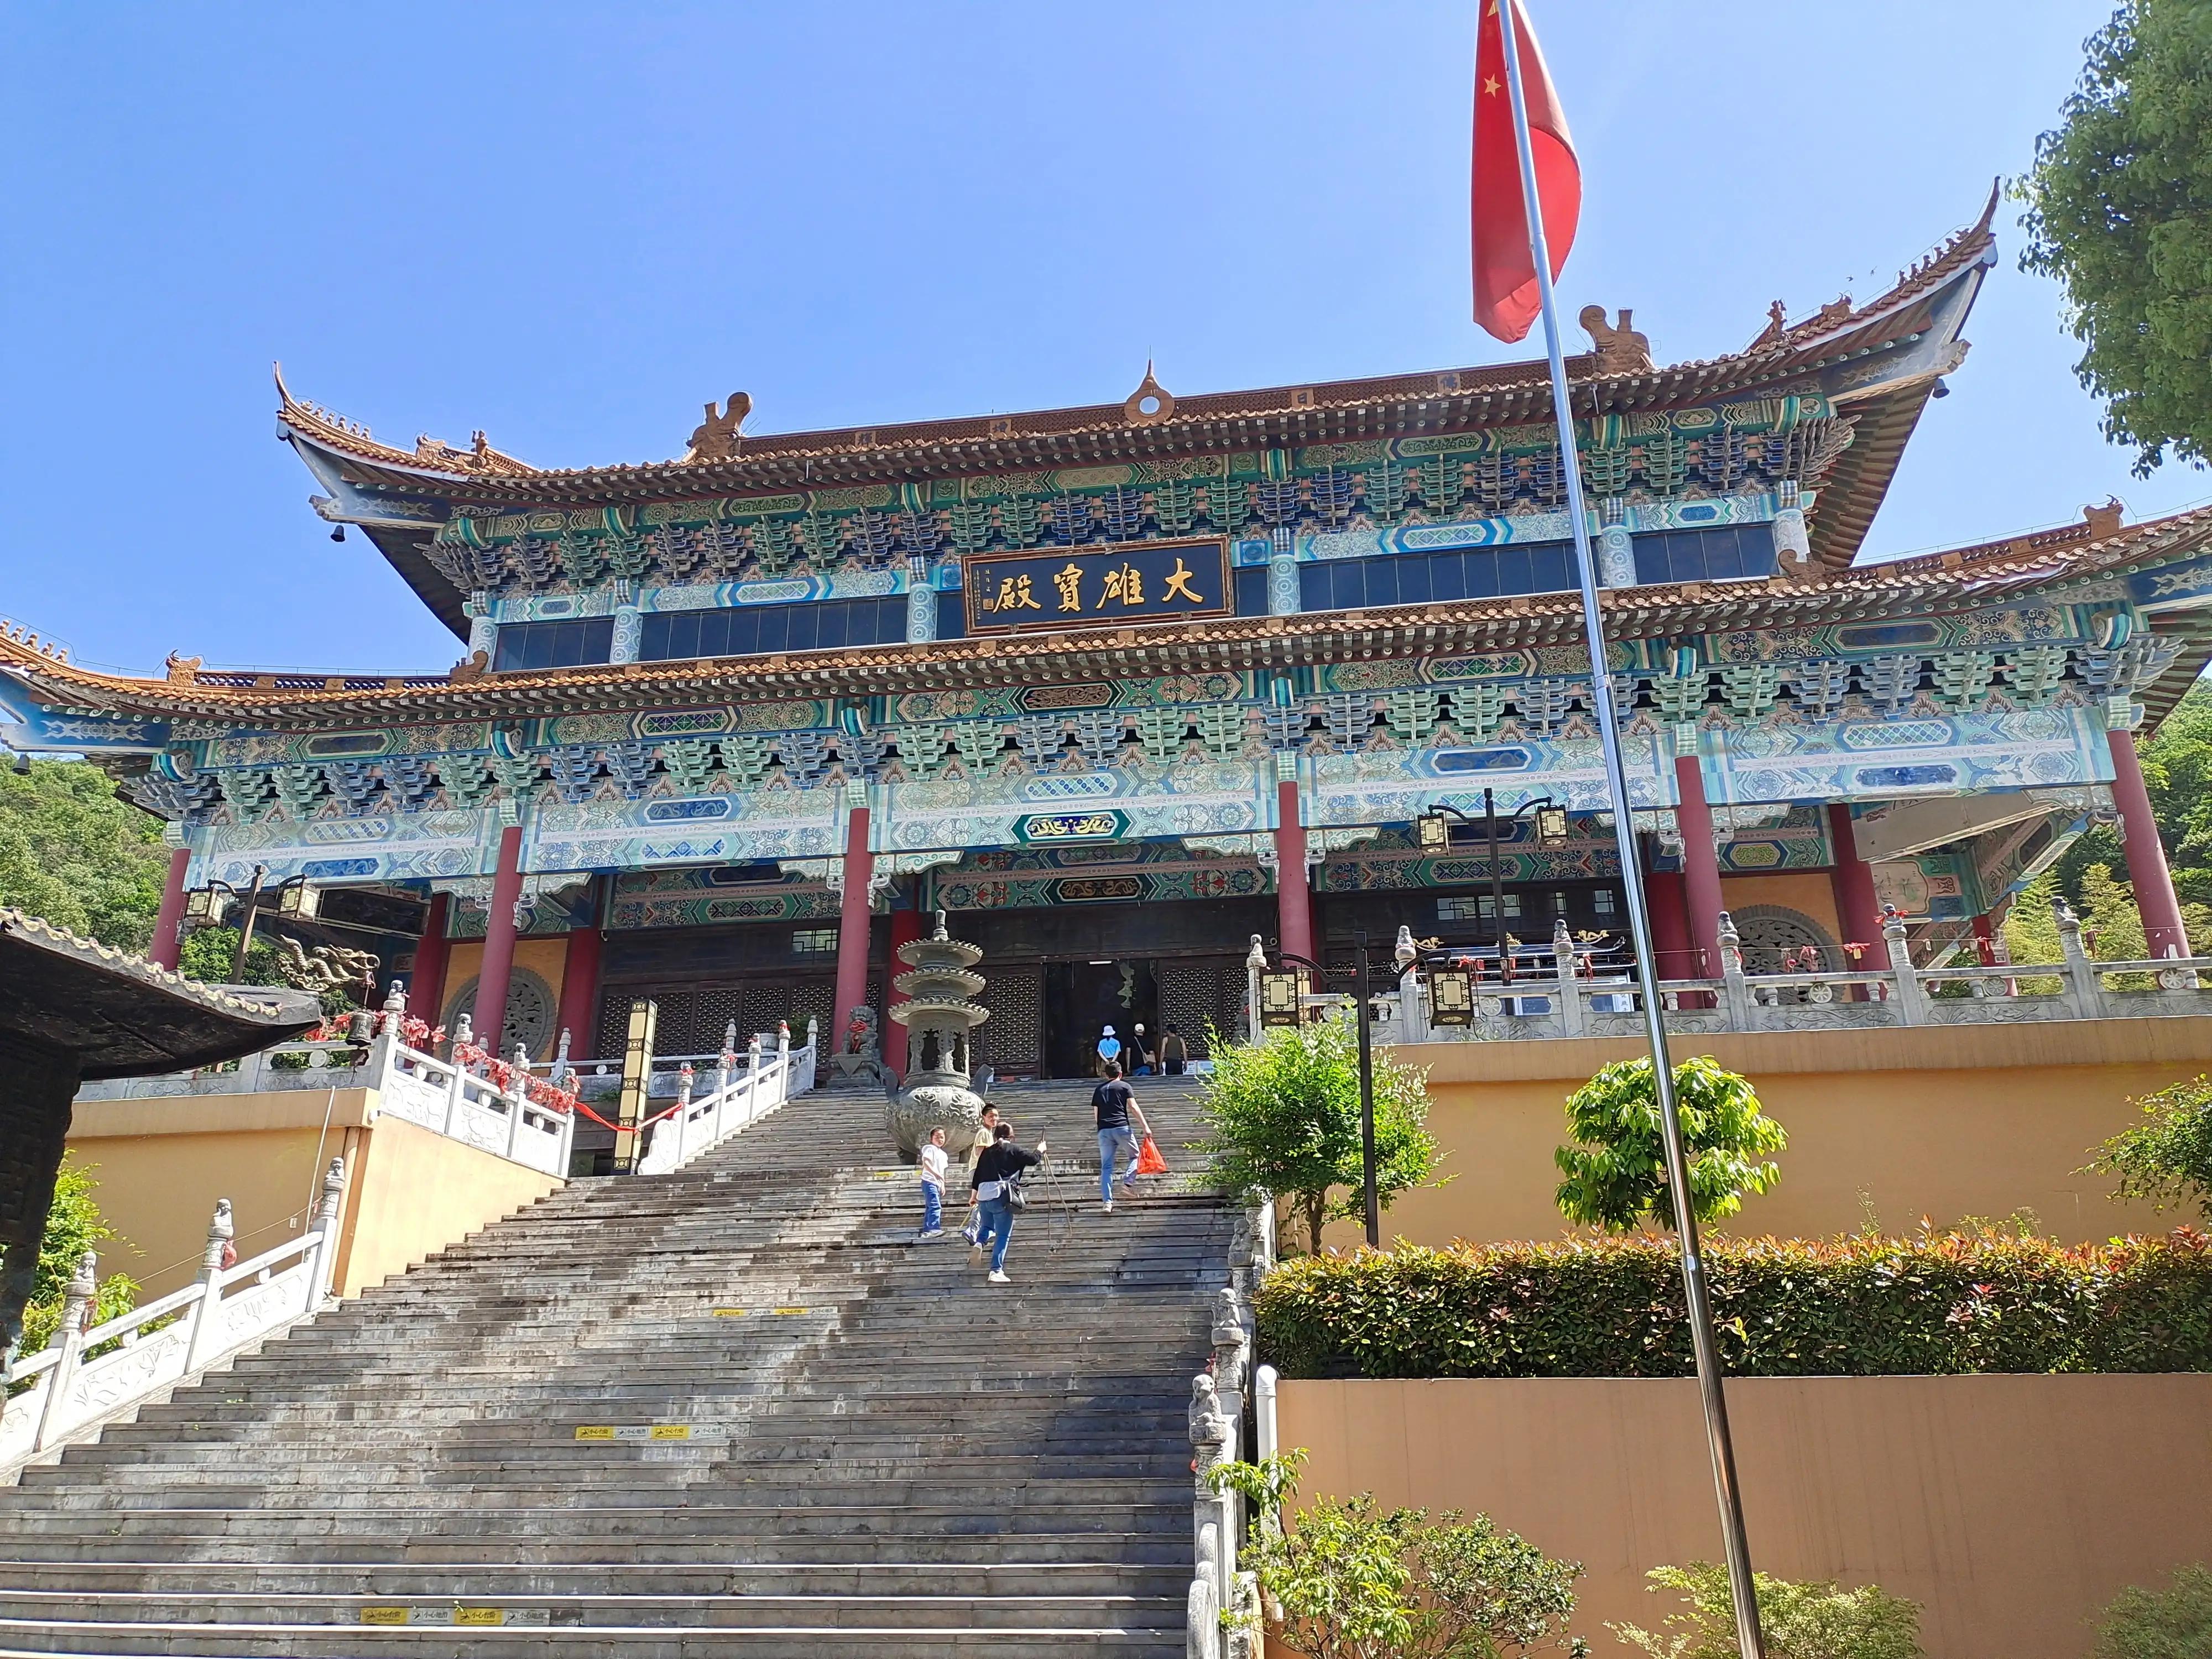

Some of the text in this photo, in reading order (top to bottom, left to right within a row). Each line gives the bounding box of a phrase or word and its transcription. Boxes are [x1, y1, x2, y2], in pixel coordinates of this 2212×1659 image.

[1297, 392, 1308, 405] 日
[993, 557, 1204, 614] 大雄寶殿
